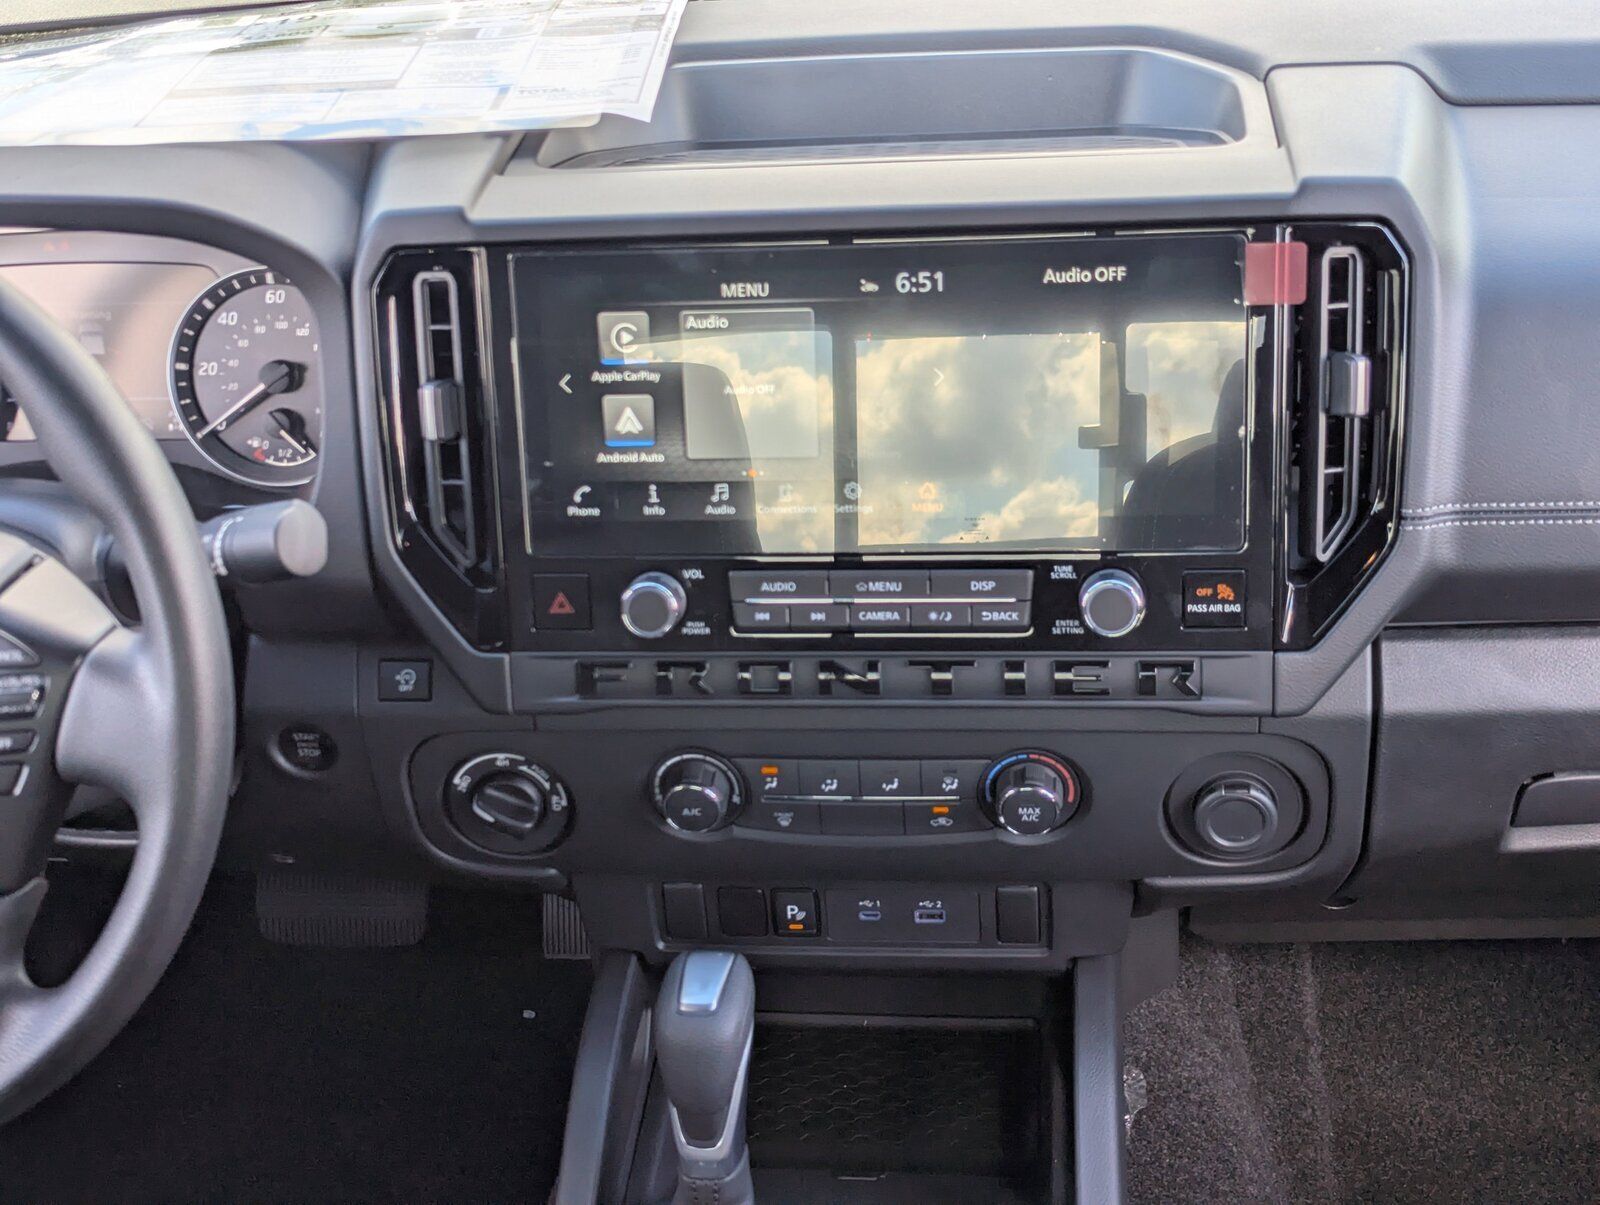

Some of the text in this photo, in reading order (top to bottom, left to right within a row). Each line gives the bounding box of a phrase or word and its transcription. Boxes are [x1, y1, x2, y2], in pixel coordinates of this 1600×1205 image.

[1042, 266, 1127, 284] Audio OFF
[895, 271, 945, 293] 6:51
[720, 282, 770, 298] MENU
[265, 289, 285, 304] 60
[217, 311, 238, 326] 40
[685, 316, 729, 330] Audio
[198, 361, 218, 376] 20
[591, 370, 661, 382] Apple CarPlay
[278, 448, 293, 458] 1/2
[597, 452, 665, 463] Android Auto
[567, 505, 600, 516] Phone
[643, 505, 665, 516] Info
[705, 504, 736, 516] Audio
[682, 569, 705, 580] VOL
[1053, 565, 1074, 573] TUNE
[1050, 572, 1078, 580] SCROLL
[760, 581, 796, 592] AUDIO
[868, 581, 903, 592] MENU
[970, 580, 996, 592] DISP
[1195, 587, 1213, 597] OFF
[1187, 603, 1241, 613] PASS AIR BAG
[858, 610, 901, 622] CAMERA
[992, 610, 1019, 622] BACK
[1055, 619, 1080, 627] ENTER
[1052, 626, 1085, 635] SETTING
[575, 659, 1200, 697] FRONTIER
[681, 807, 702, 817] A/C
[1017, 806, 1042, 816] MAX
[1022, 814, 1040, 823] A/C
